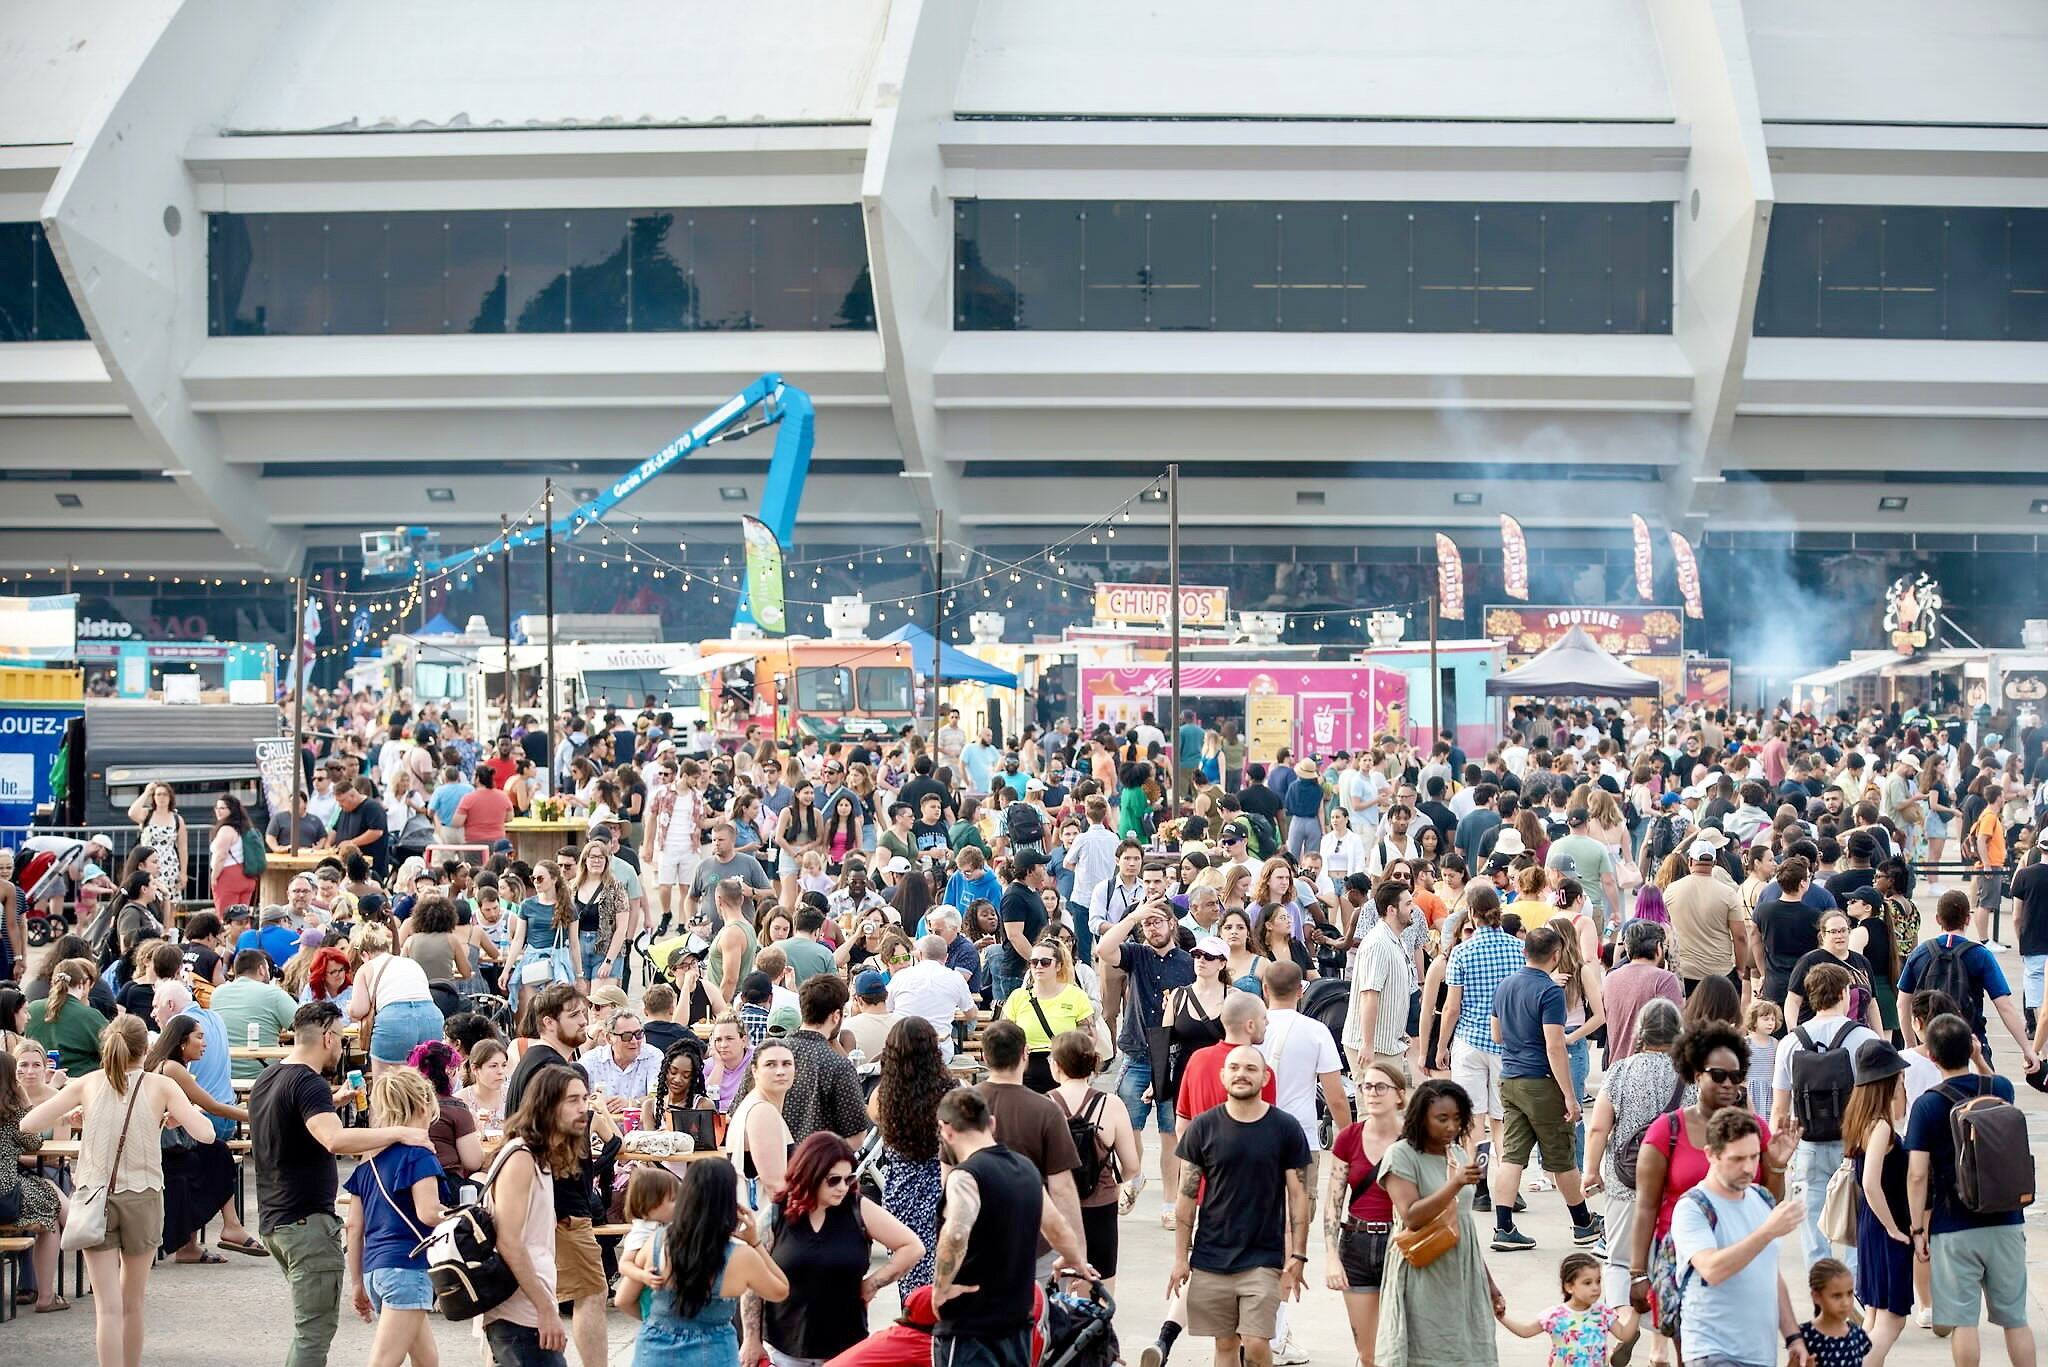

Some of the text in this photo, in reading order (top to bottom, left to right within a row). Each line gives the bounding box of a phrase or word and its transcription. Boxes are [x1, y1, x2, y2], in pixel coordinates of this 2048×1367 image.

[1109, 590, 1212, 618] CHUROS
[1547, 609, 1620, 629] POUTINE
[607, 654, 667, 667] MIGNON
[0, 716, 68, 735] OUEZ-
[255, 742, 295, 761] GRILLE
[261, 757, 295, 776] CHEES
